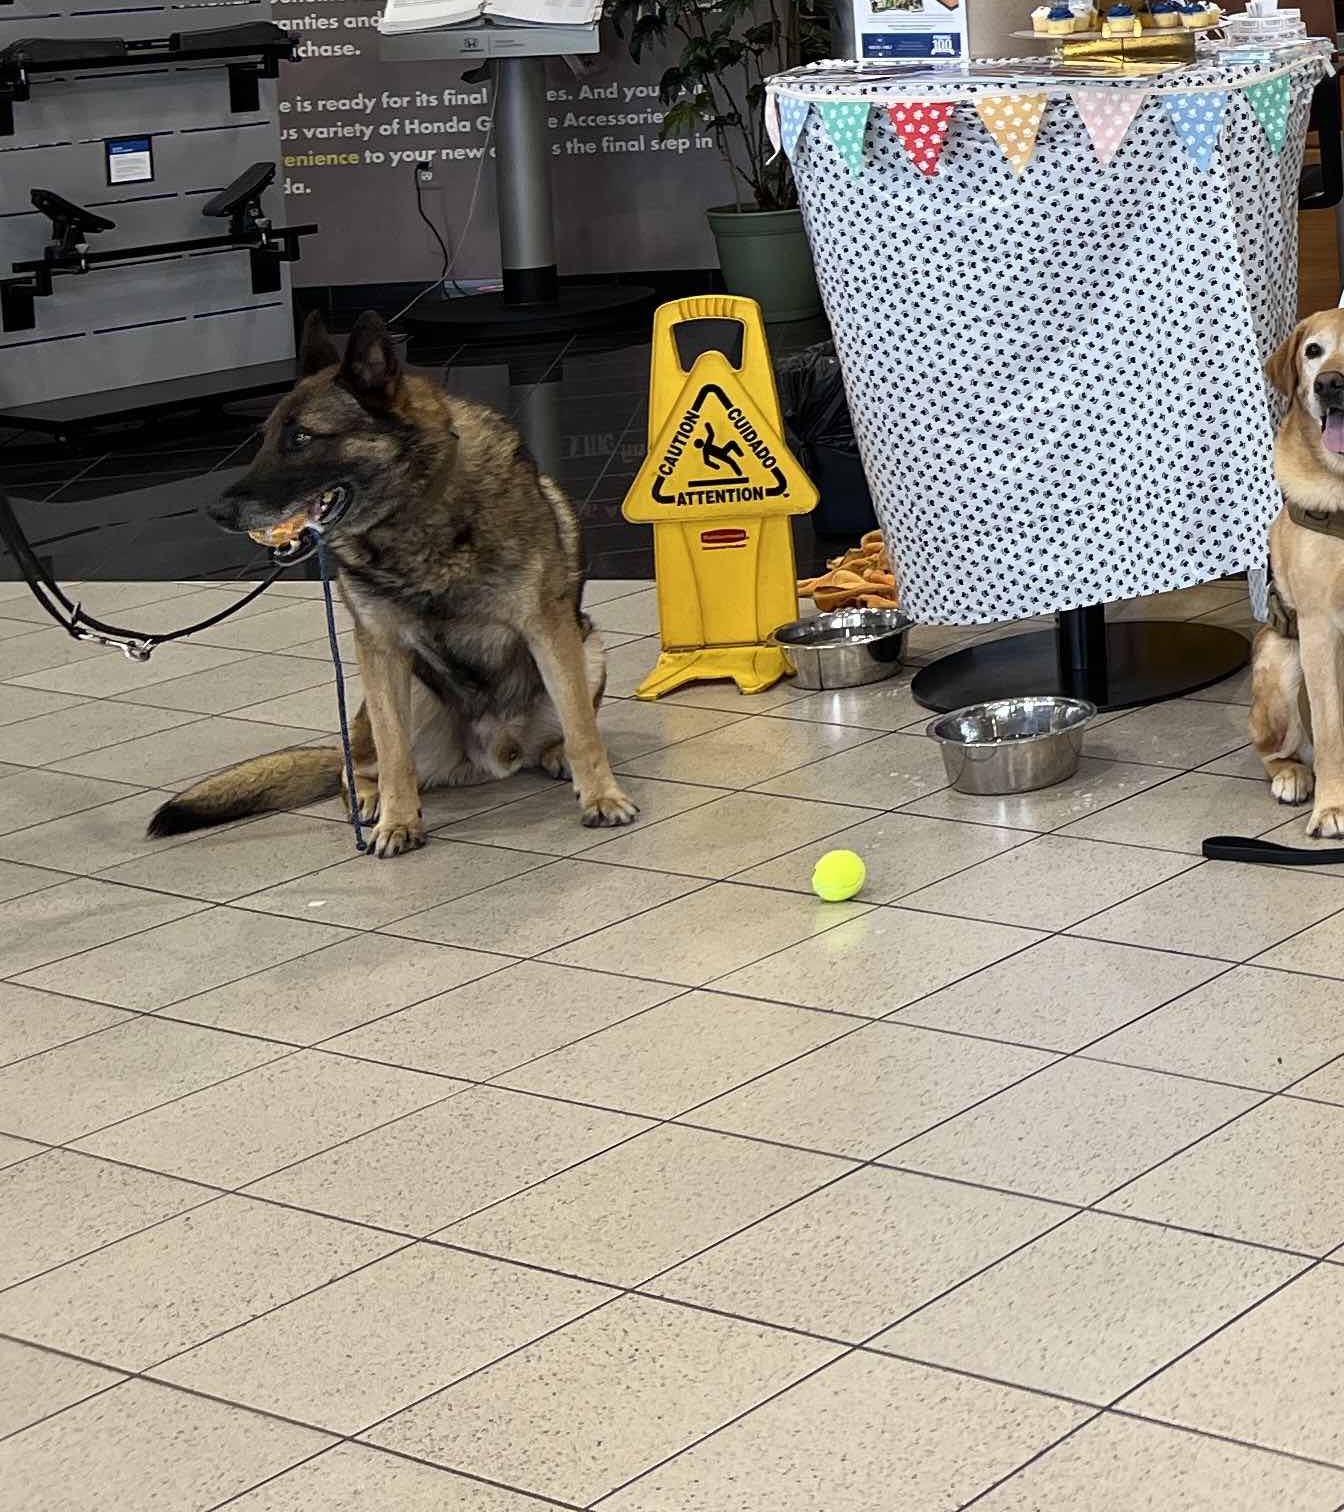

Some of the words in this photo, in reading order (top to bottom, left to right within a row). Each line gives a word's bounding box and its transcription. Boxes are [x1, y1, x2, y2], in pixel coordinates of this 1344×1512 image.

[317, 93, 376, 114] ready
[443, 88, 488, 106] final
[303, 122, 374, 141] variety
[659, 410, 700, 476] CAUTION
[728, 408, 777, 469] CUIDADO
[677, 486, 764, 506] ATTENTION
